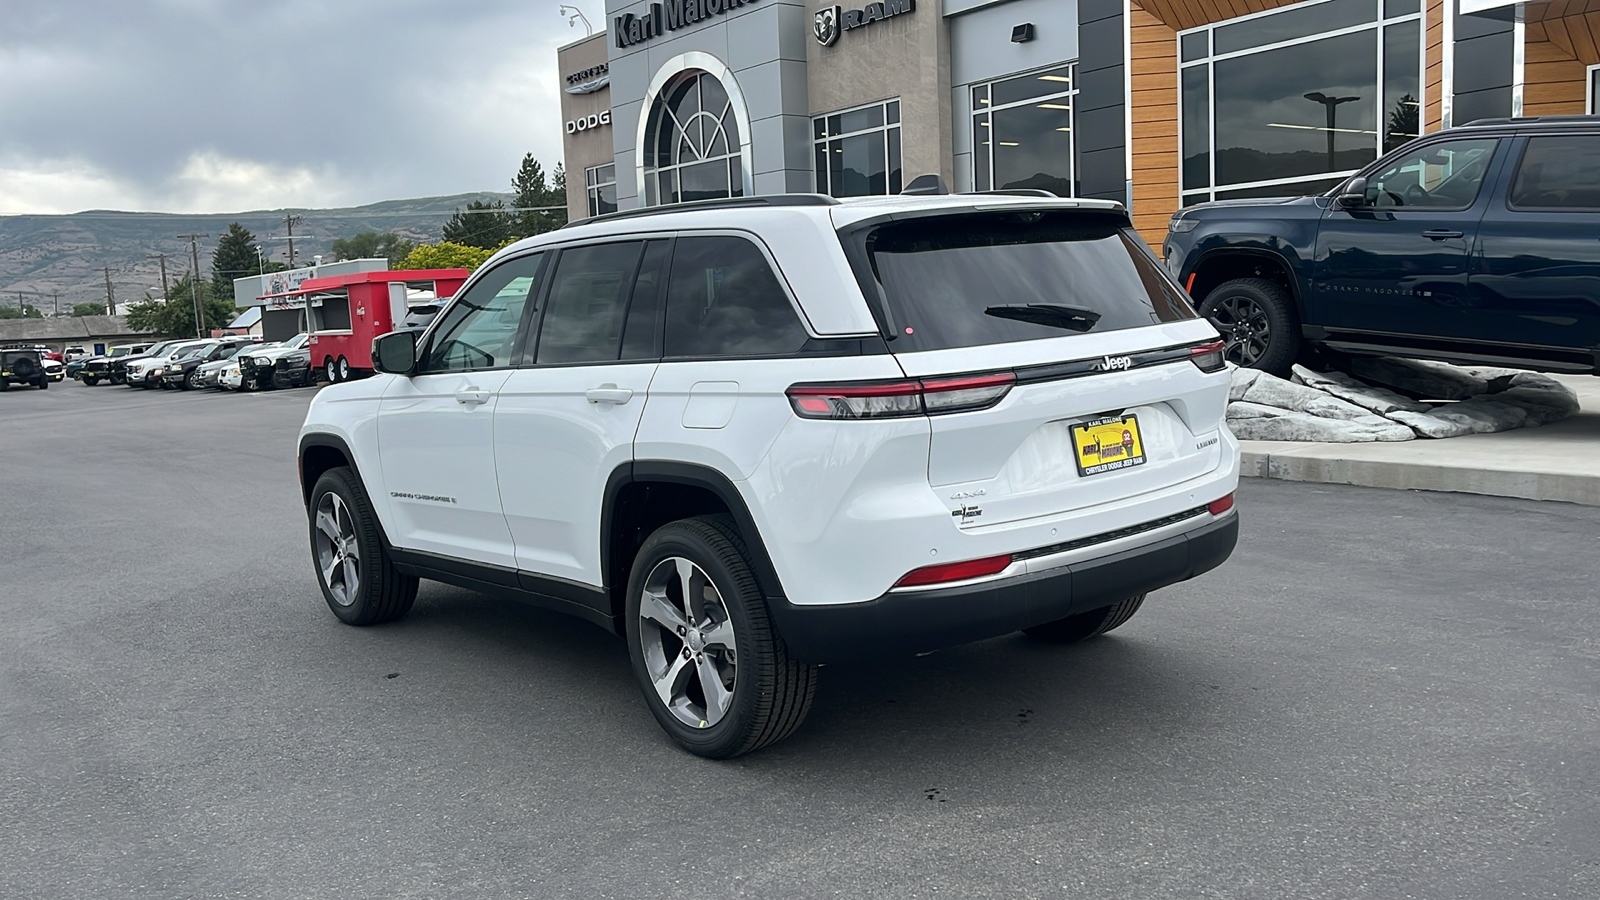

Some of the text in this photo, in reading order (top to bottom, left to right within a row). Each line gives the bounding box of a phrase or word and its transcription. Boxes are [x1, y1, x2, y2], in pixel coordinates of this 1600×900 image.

[613, 0, 754, 48] Karl Malo
[841, 0, 914, 31] RAM
[566, 63, 609, 84] CHRYSLE
[566, 110, 611, 134] DODG
[1365, 287, 1422, 296] WAGONEER
[1101, 355, 1131, 371] Jeep
[1102, 417, 1122, 425] MALONE
[1085, 457, 1144, 475] CHRYSLER DODGE JEEP RAM
